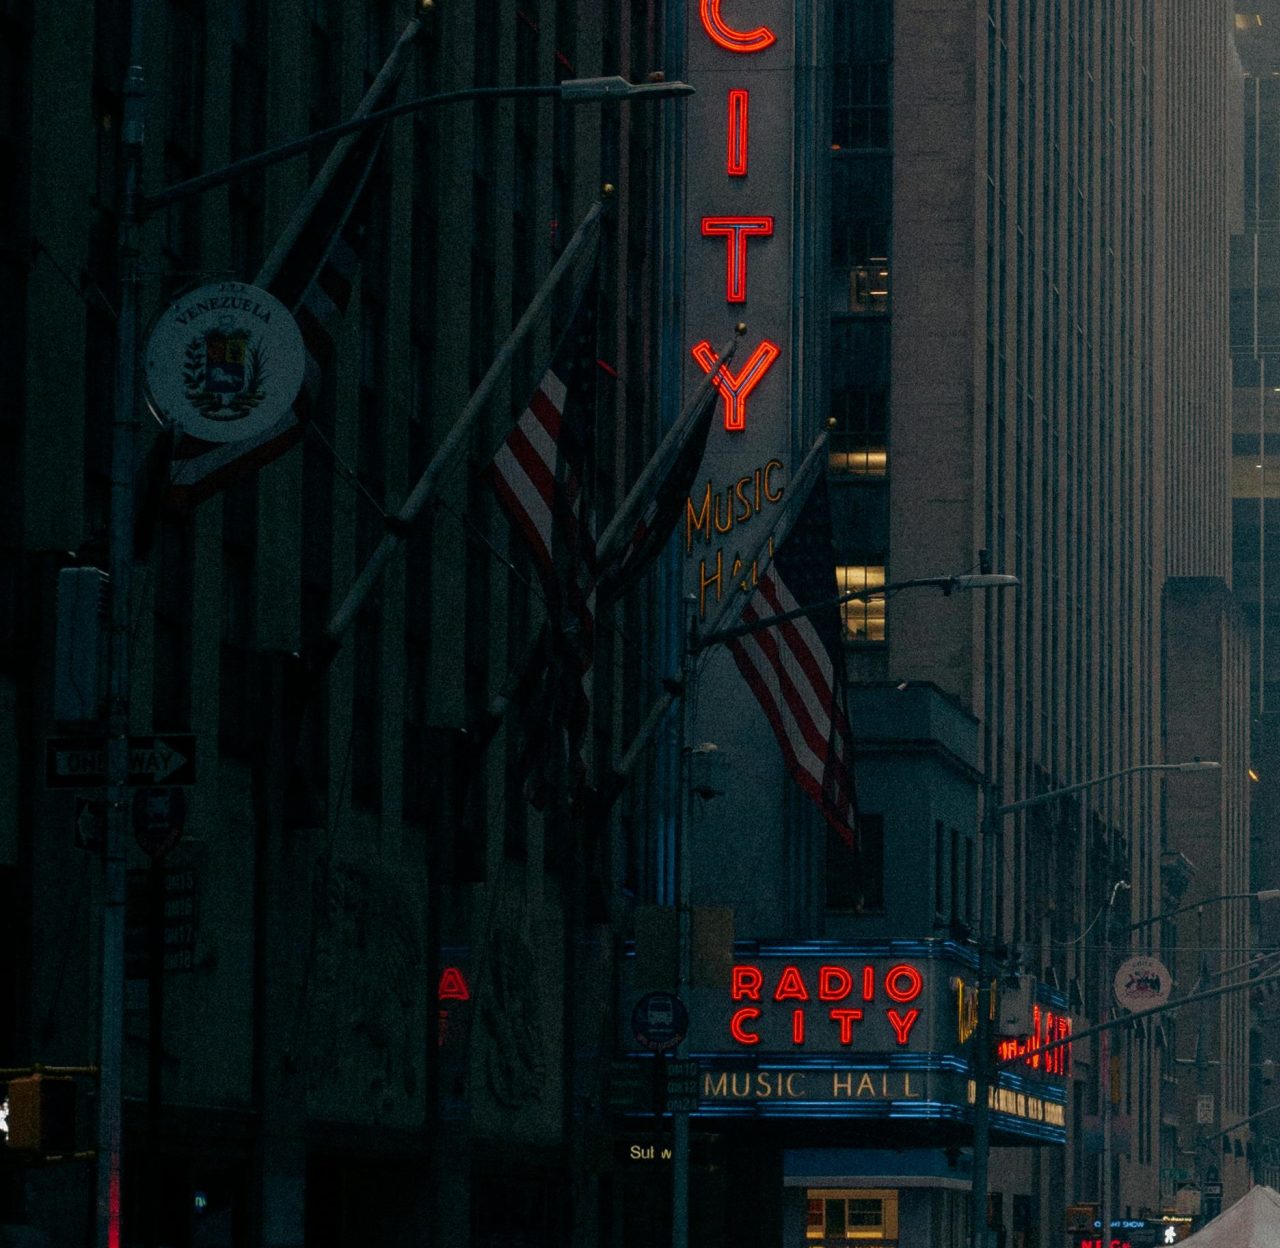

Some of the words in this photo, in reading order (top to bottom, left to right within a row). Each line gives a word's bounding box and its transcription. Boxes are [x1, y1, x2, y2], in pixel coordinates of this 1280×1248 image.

[692, 0, 781, 431] CITY
[176, 297, 271, 326] VENEZUELA
[686, 459, 784, 557] MUSIC
[731, 965, 923, 1003] RADIO
[730, 1006, 920, 1046] CITY
[703, 1072, 807, 1098] MUSIC
[832, 1072, 920, 1098] HALL
